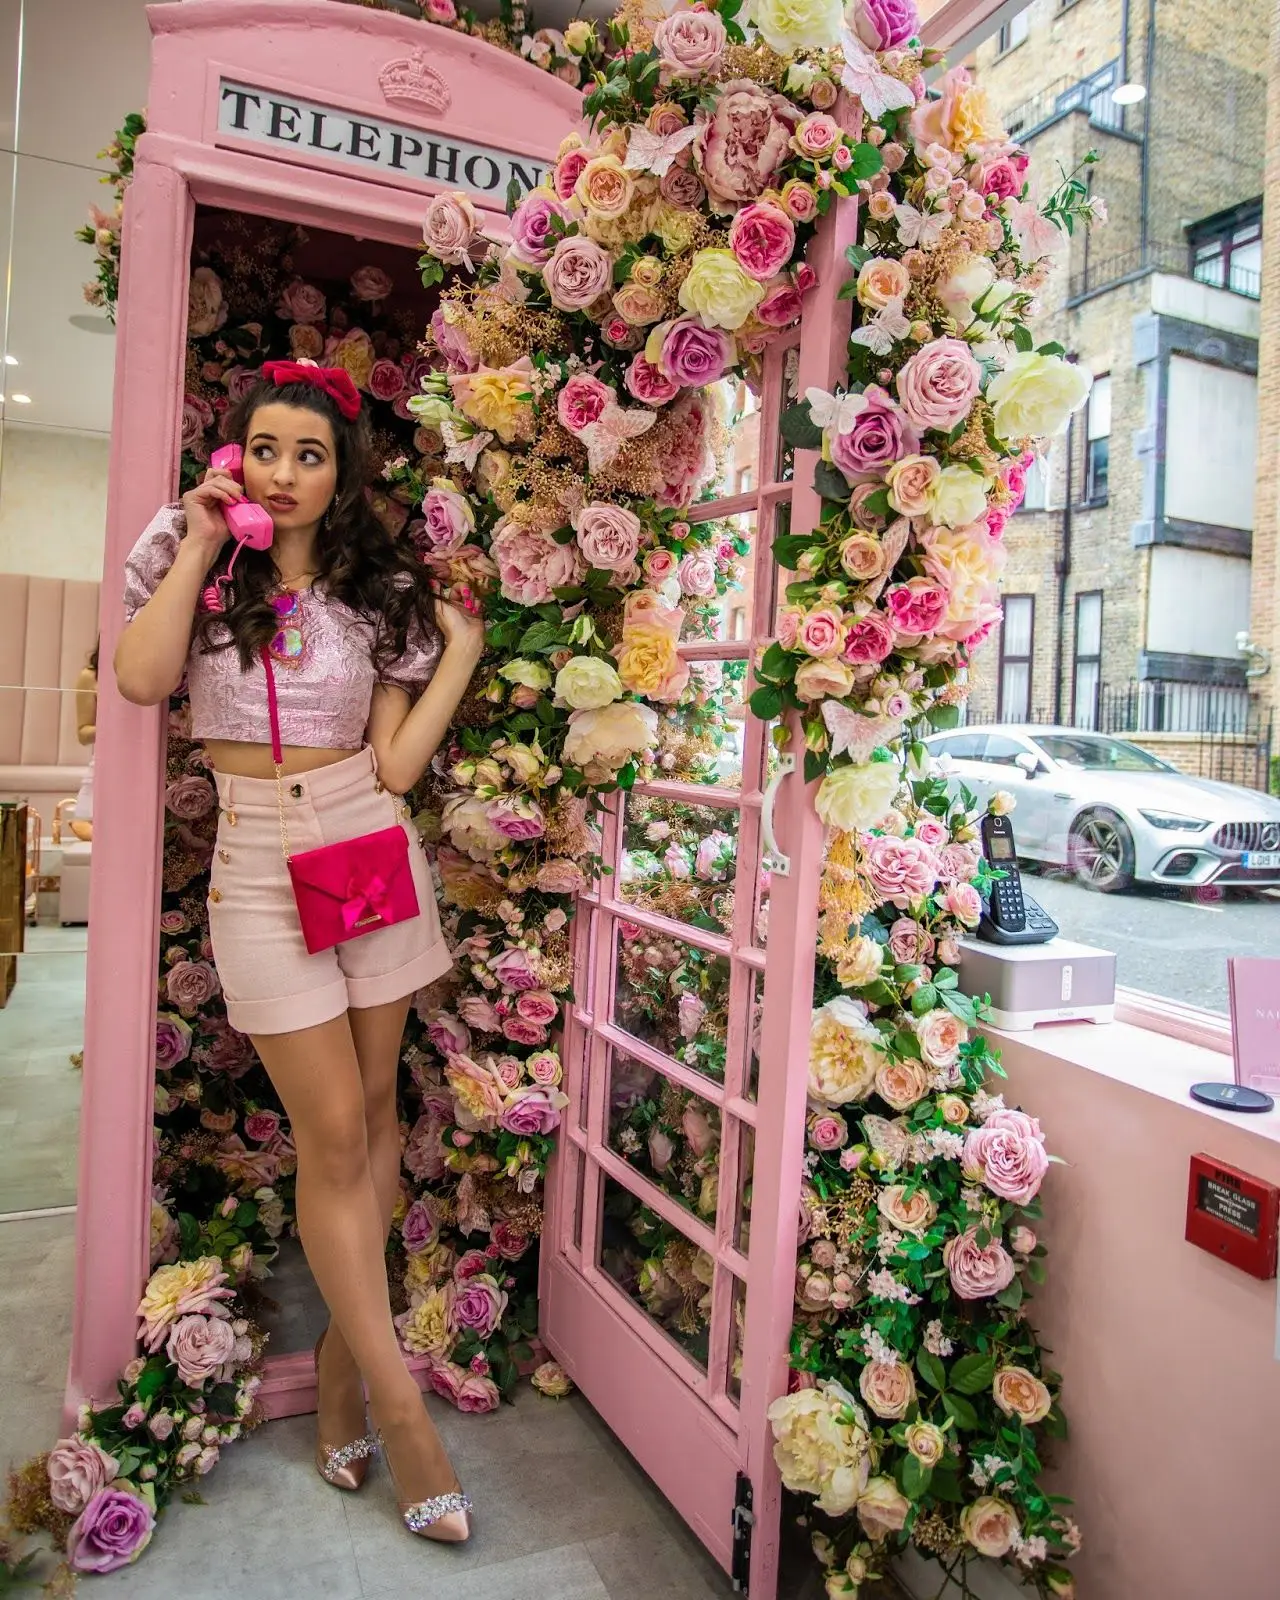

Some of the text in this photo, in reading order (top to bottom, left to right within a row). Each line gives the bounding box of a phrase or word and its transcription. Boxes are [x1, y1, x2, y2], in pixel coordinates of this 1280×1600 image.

[1207, 1180, 1256, 1209] BREAK GLASS
[1218, 1202, 1241, 1220] PRESS
